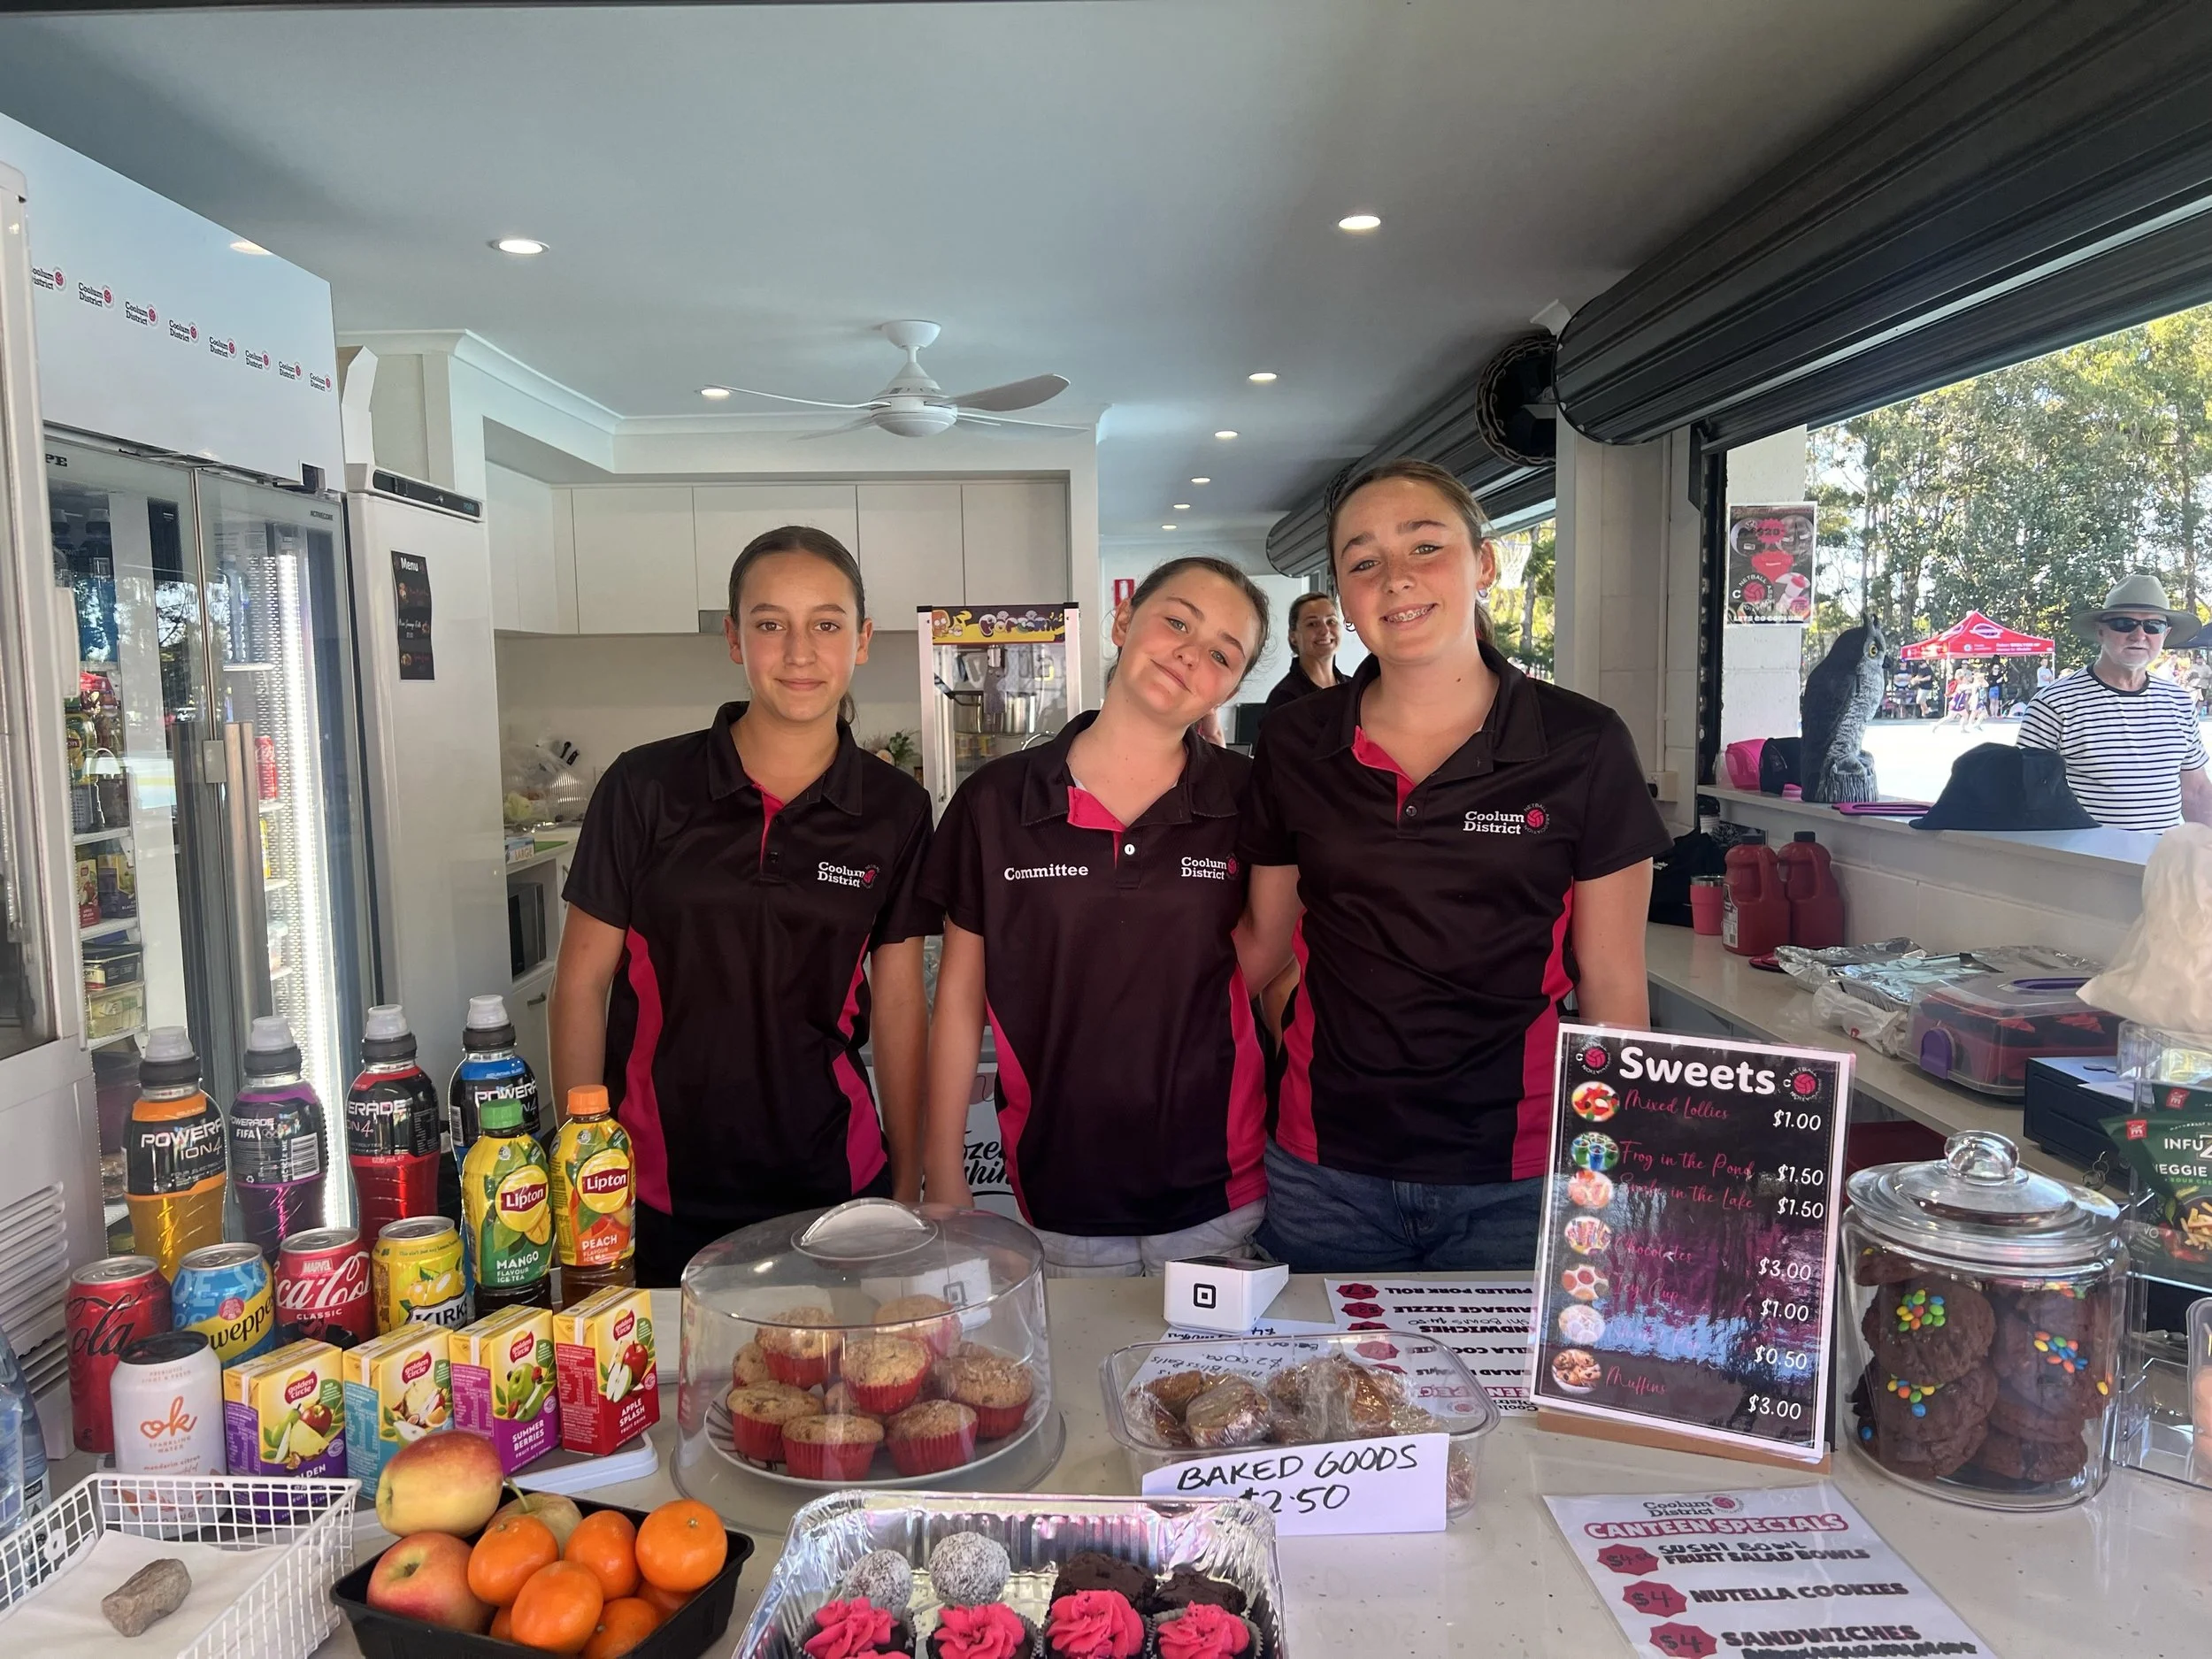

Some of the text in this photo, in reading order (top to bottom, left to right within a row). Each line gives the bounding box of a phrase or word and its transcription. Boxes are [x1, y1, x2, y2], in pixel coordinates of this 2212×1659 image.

[32, 267, 54, 281] oolum
[33, 277, 53, 290] istrict
[78, 282, 103, 298] Coolum
[79, 291, 103, 307] District
[125, 301, 148, 317] Coolum
[126, 310, 148, 326] District
[169, 319, 190, 334] Coolum
[170, 328, 189, 342] District
[209, 336, 228, 350] Coolum
[210, 345, 228, 357] District
[401, 557, 419, 572] Menu
[1739, 574, 1767, 586] NETBALL
[1465, 811, 1525, 823] Coolum
[1463, 821, 1522, 834] District
[818, 862, 865, 878] Coolum
[1181, 856, 1227, 870] Coolum
[818, 871, 860, 887] District
[1004, 864, 1089, 881] Committee
[1181, 867, 1225, 880] District
[1619, 1046, 1775, 1094] Sweets
[1624, 1089, 1728, 1119] Mixed Lollies
[1772, 1109, 1821, 1131] $1.00
[236, 1129, 255, 1139] FIFA
[1620, 1141, 1755, 1178] Frog in the Pond
[587, 1173, 626, 1191] Lipton
[1778, 1164, 1824, 1186] $1.50
[506, 1187, 543, 1208] Lipton
[1670, 1187, 1686, 1200] in
[1687, 1186, 1714, 1202] the
[1722, 1188, 1755, 1210] Lake
[1778, 1196, 1824, 1219] $1.50
[582, 1234, 618, 1250] PEACH
[496, 1250, 539, 1269] MANGO
[583, 1247, 608, 1256] FLAVOUR
[303, 1258, 332, 1272] MARVEL
[496, 1267, 529, 1277] FLAVOUR
[1758, 1256, 1811, 1280] $3.00
[1648, 1279, 1678, 1301] Cup
[296, 1309, 342, 1320] CLASSIC
[1761, 1297, 1809, 1322] $1.00
[209, 1296, 273, 1351] weppe
[615, 1317, 634, 1333] golden
[511, 1338, 532, 1354] golden
[514, 1346, 529, 1358] circle
[1754, 1345, 1807, 1370] $0.50
[405, 1358, 428, 1375] golden
[408, 1366, 426, 1379] circle
[288, 1378, 314, 1394] golden
[1606, 1365, 1666, 1395] Muffins
[290, 1386, 311, 1399] circle
[1486, 1387, 1529, 1398] EEN
[621, 1398, 642, 1417] APPLE
[1748, 1394, 1801, 1420] $3.00
[140, 1396, 197, 1439] ok
[619, 1406, 645, 1427] SPLASH
[512, 1419, 544, 1443] SUMMER
[620, 1423, 632, 1433] FRUIT
[149, 1435, 191, 1448] SPARKLING
[514, 1429, 544, 1451] BERRIES
[157, 1445, 184, 1454] WATER
[516, 1440, 544, 1458] FRUIT DRINK
[1177, 1445, 1419, 1491] BAKED GOODS
[1642, 1500, 1713, 1509] Coolum
[1647, 1508, 1715, 1517] District
[1585, 1514, 1848, 1539] CANTEEN SPECIALS
[1658, 1540, 1806, 1555] SUSHI BOWL
[1663, 1548, 1870, 1564] FRUIT SALAD BOWLS
[1631, 1589, 1671, 1609] $4
[1689, 1582, 1909, 1603] NUTELLA COOKIES
[1658, 1634, 1701, 1652] $4
[1722, 1624, 1922, 1647] SANDWICHES
